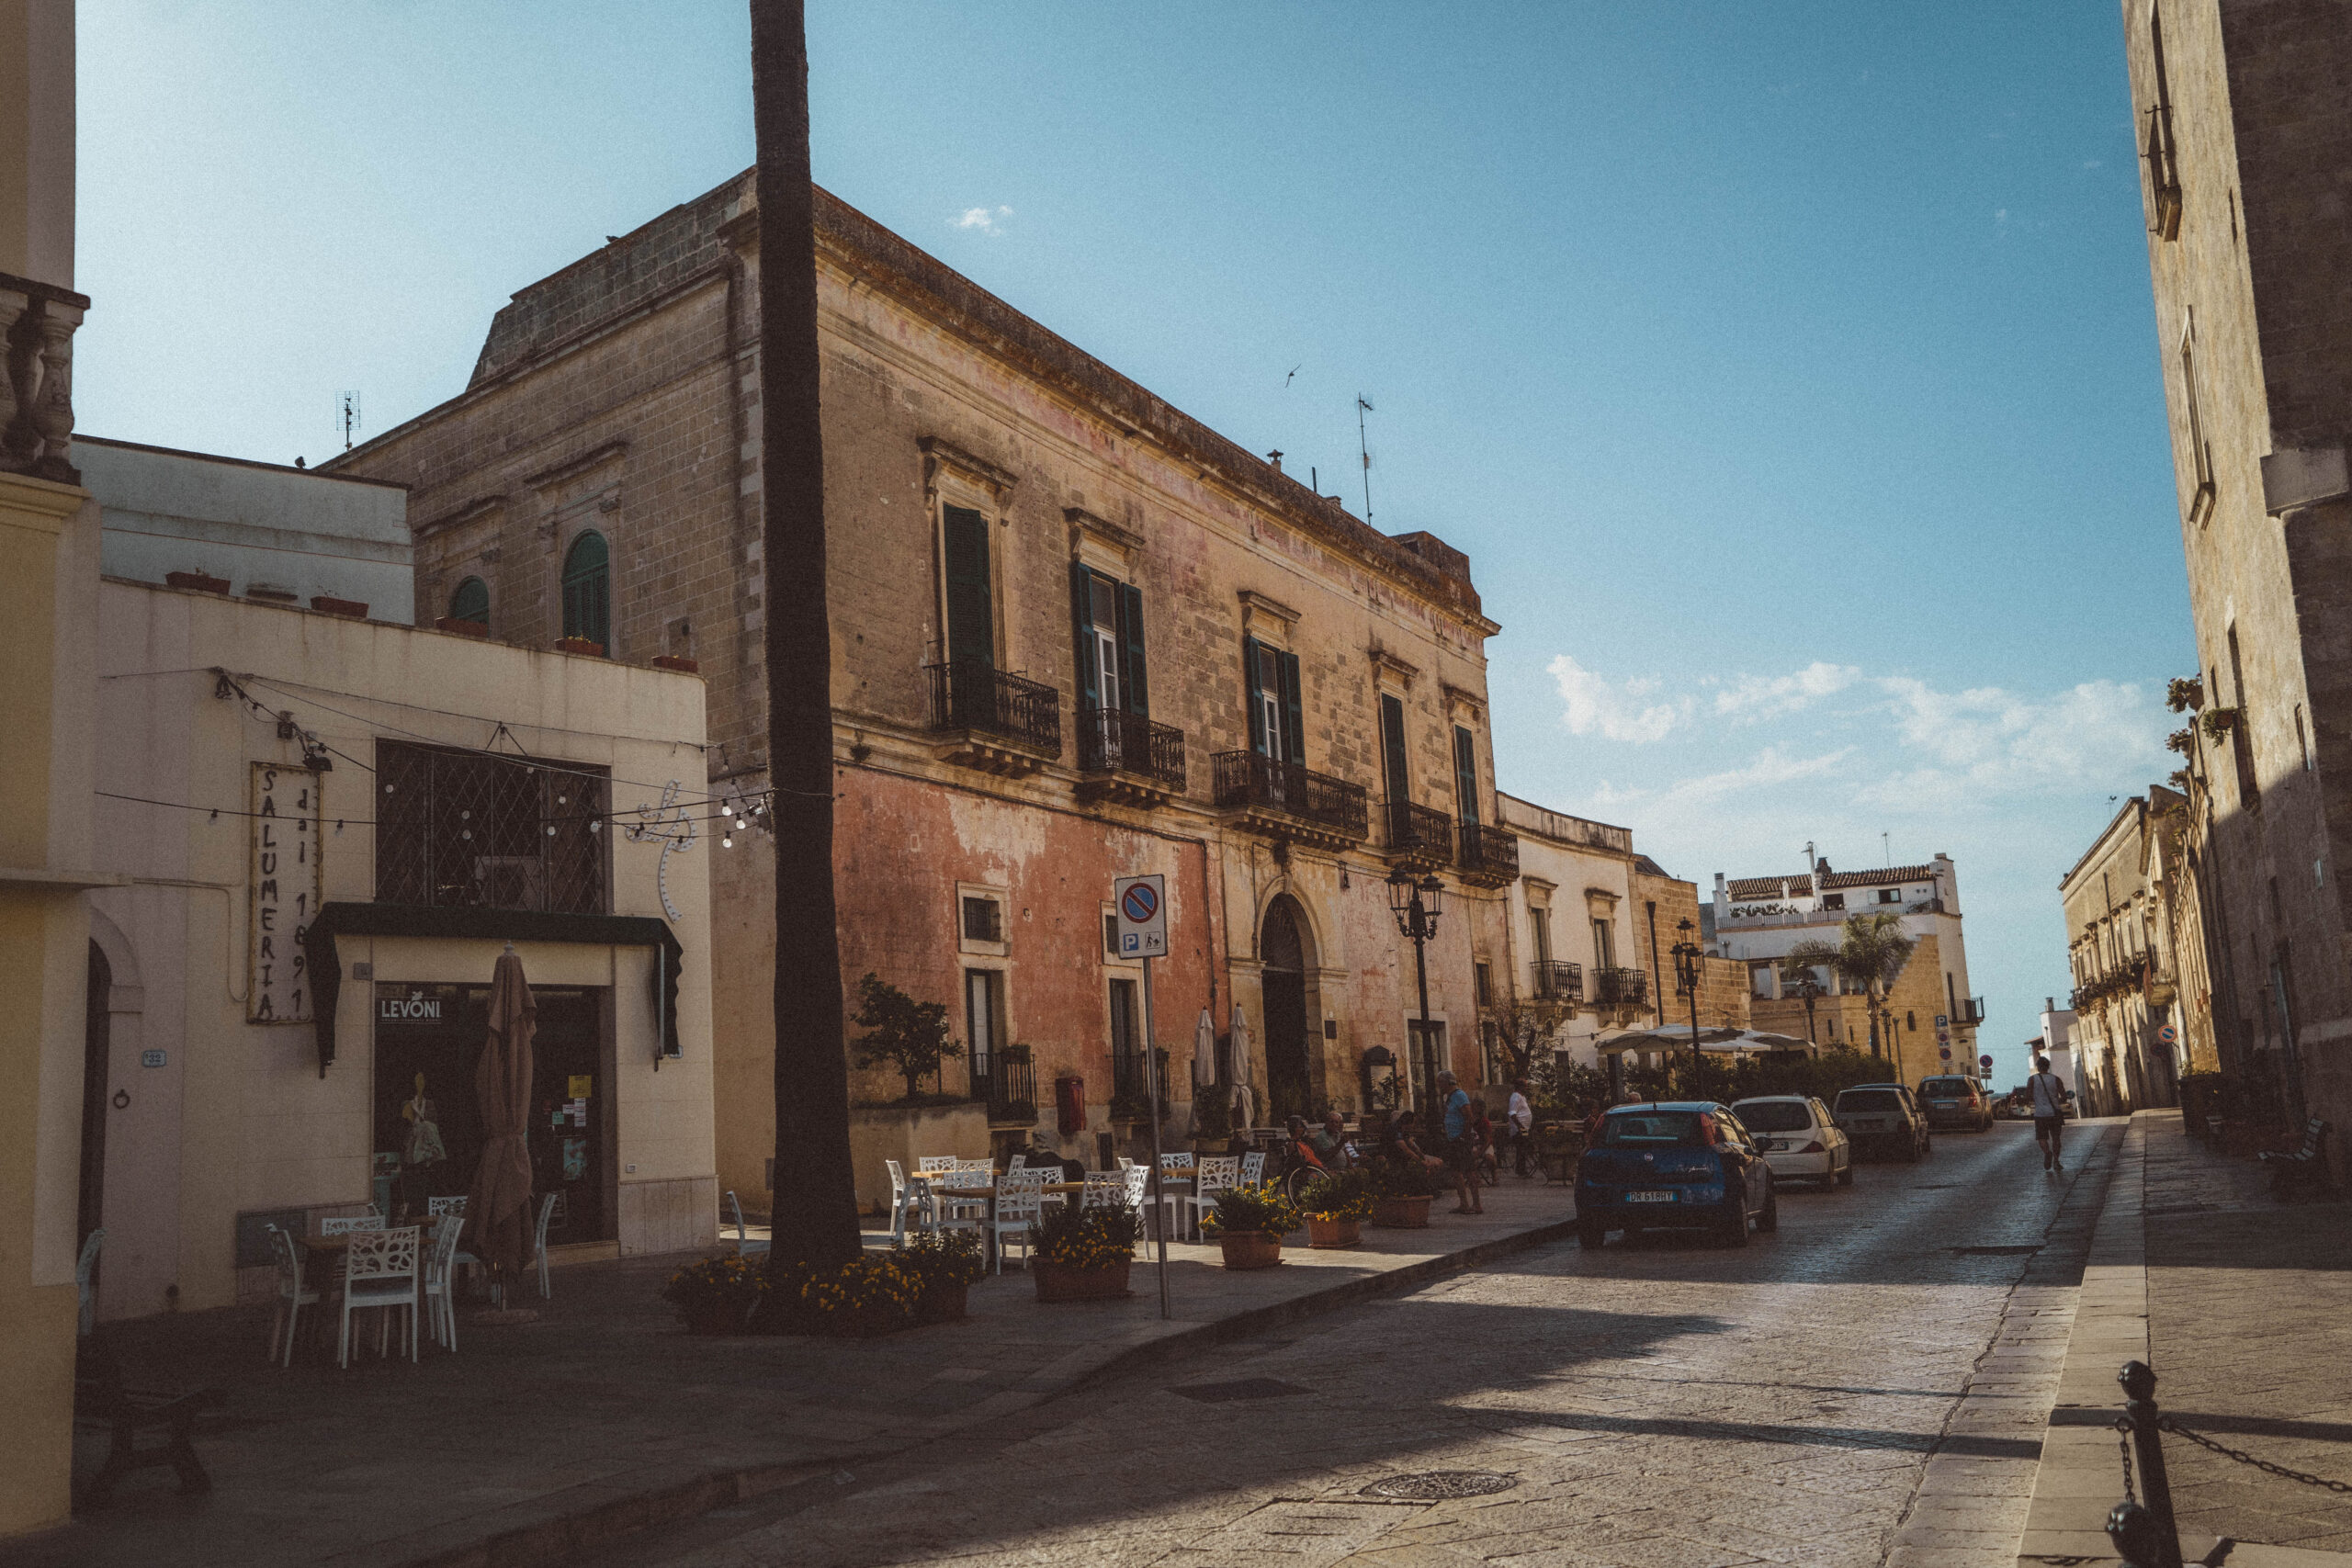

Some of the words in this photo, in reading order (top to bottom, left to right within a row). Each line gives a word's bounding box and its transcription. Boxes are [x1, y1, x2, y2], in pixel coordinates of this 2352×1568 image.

[297, 789, 309, 863] dal
[257, 771, 277, 1021] SALUMERIA
[291, 892, 308, 1013] 1891
[1125, 934, 1137, 951] P
[381, 999, 441, 1019] LEVONI
